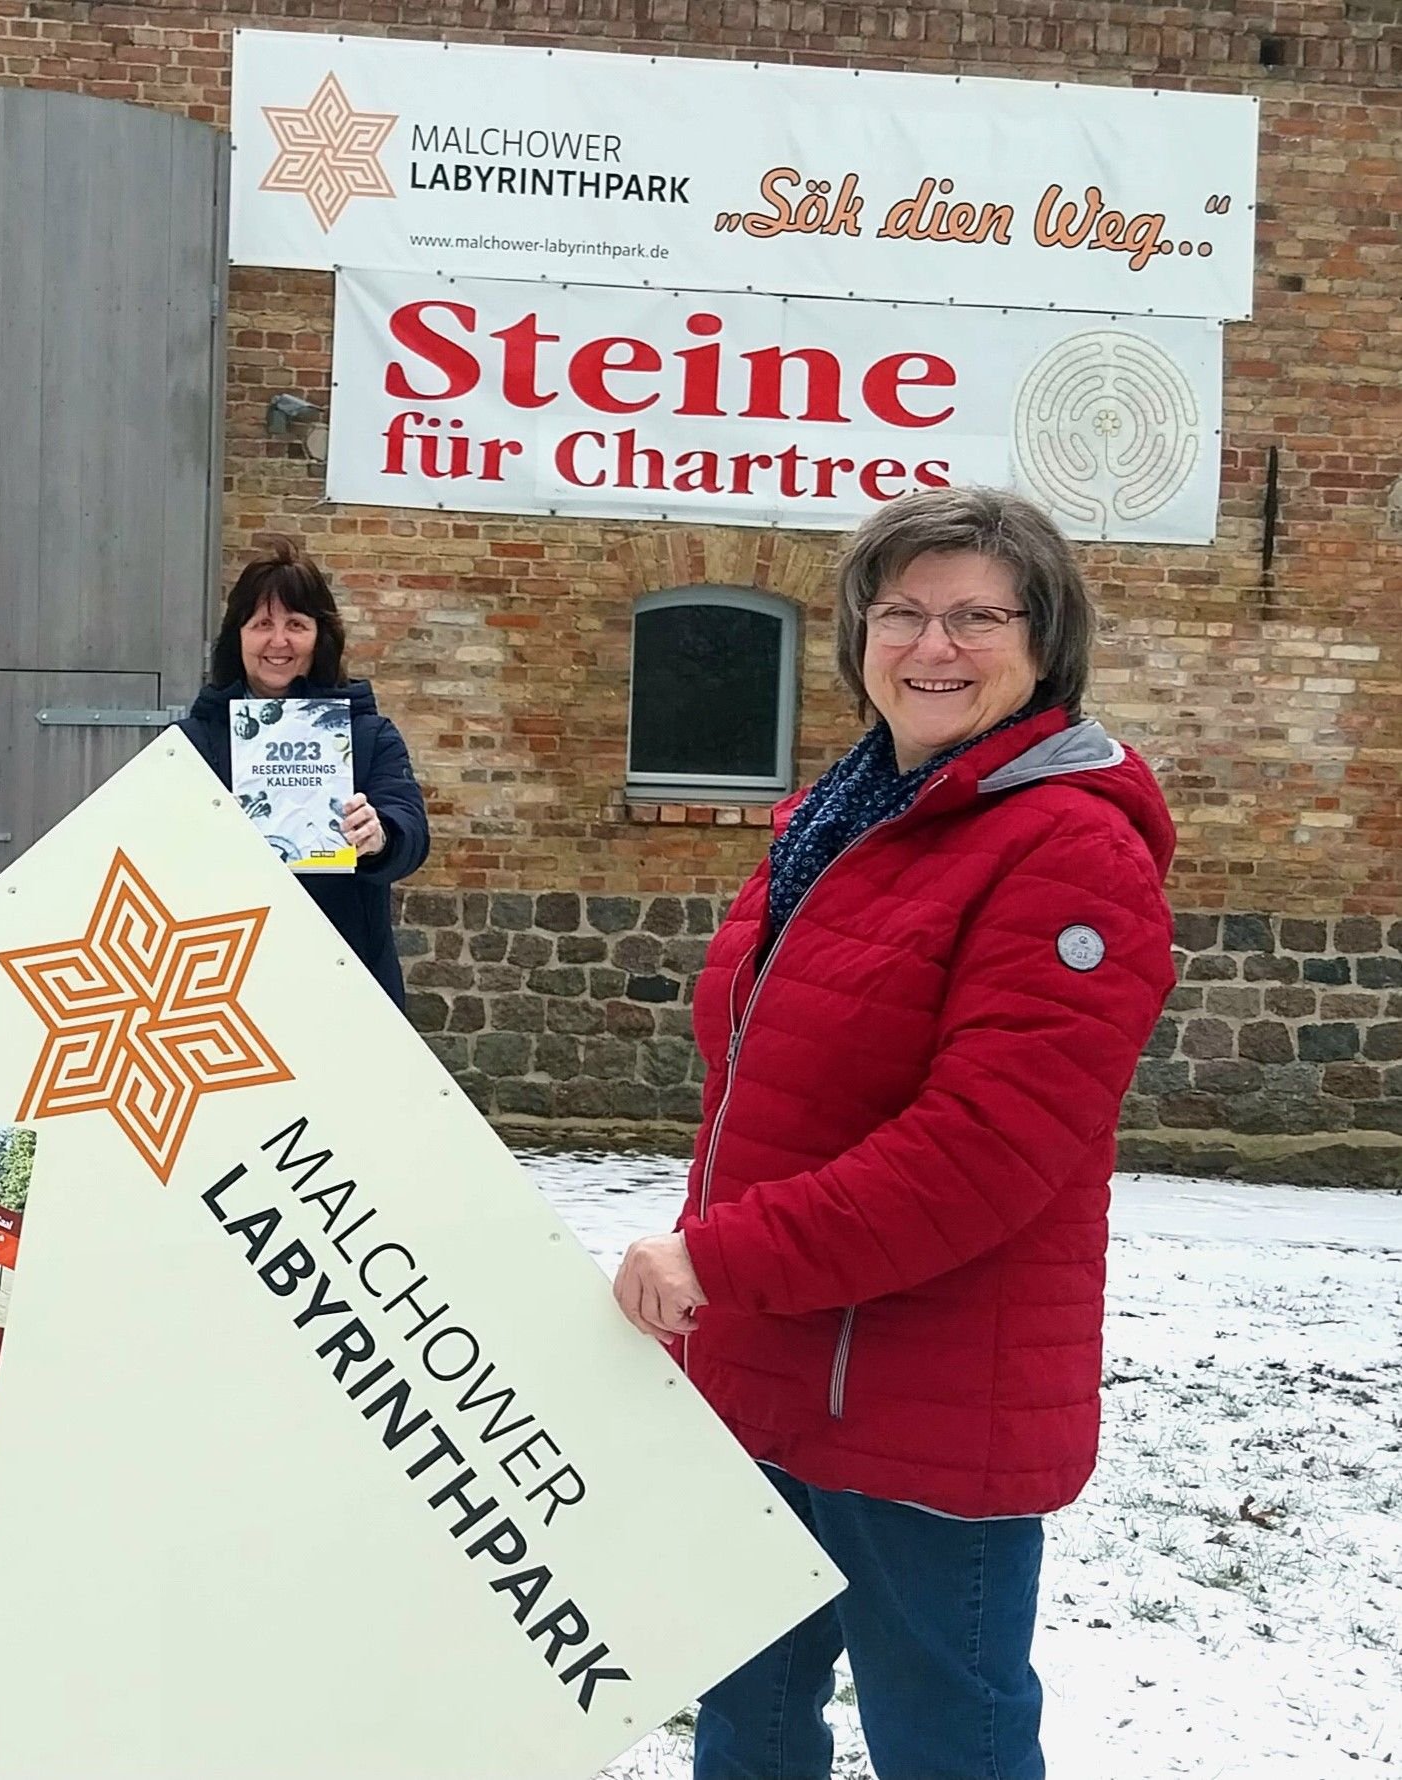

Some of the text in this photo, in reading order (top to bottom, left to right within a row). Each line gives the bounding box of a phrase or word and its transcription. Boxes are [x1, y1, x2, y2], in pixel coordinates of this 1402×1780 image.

[411, 124, 622, 163] MALCHOWER
[410, 162, 690, 204] LABYRINTHPARK
[877, 177, 1014, 245] dien
[409, 234, 670, 259] www.malchower-labyrinthpark.de
[384, 300, 957, 429] Steine
[380, 411, 951, 500] für Chartres
[252, 765, 336, 775] RESERVIERUNGS
[265, 741, 322, 761] 2023
[267, 777, 322, 787] KALENDER
[260, 1116, 587, 1527] MALCHOWER
[201, 1162, 632, 1714] LABYRINTHPARK
